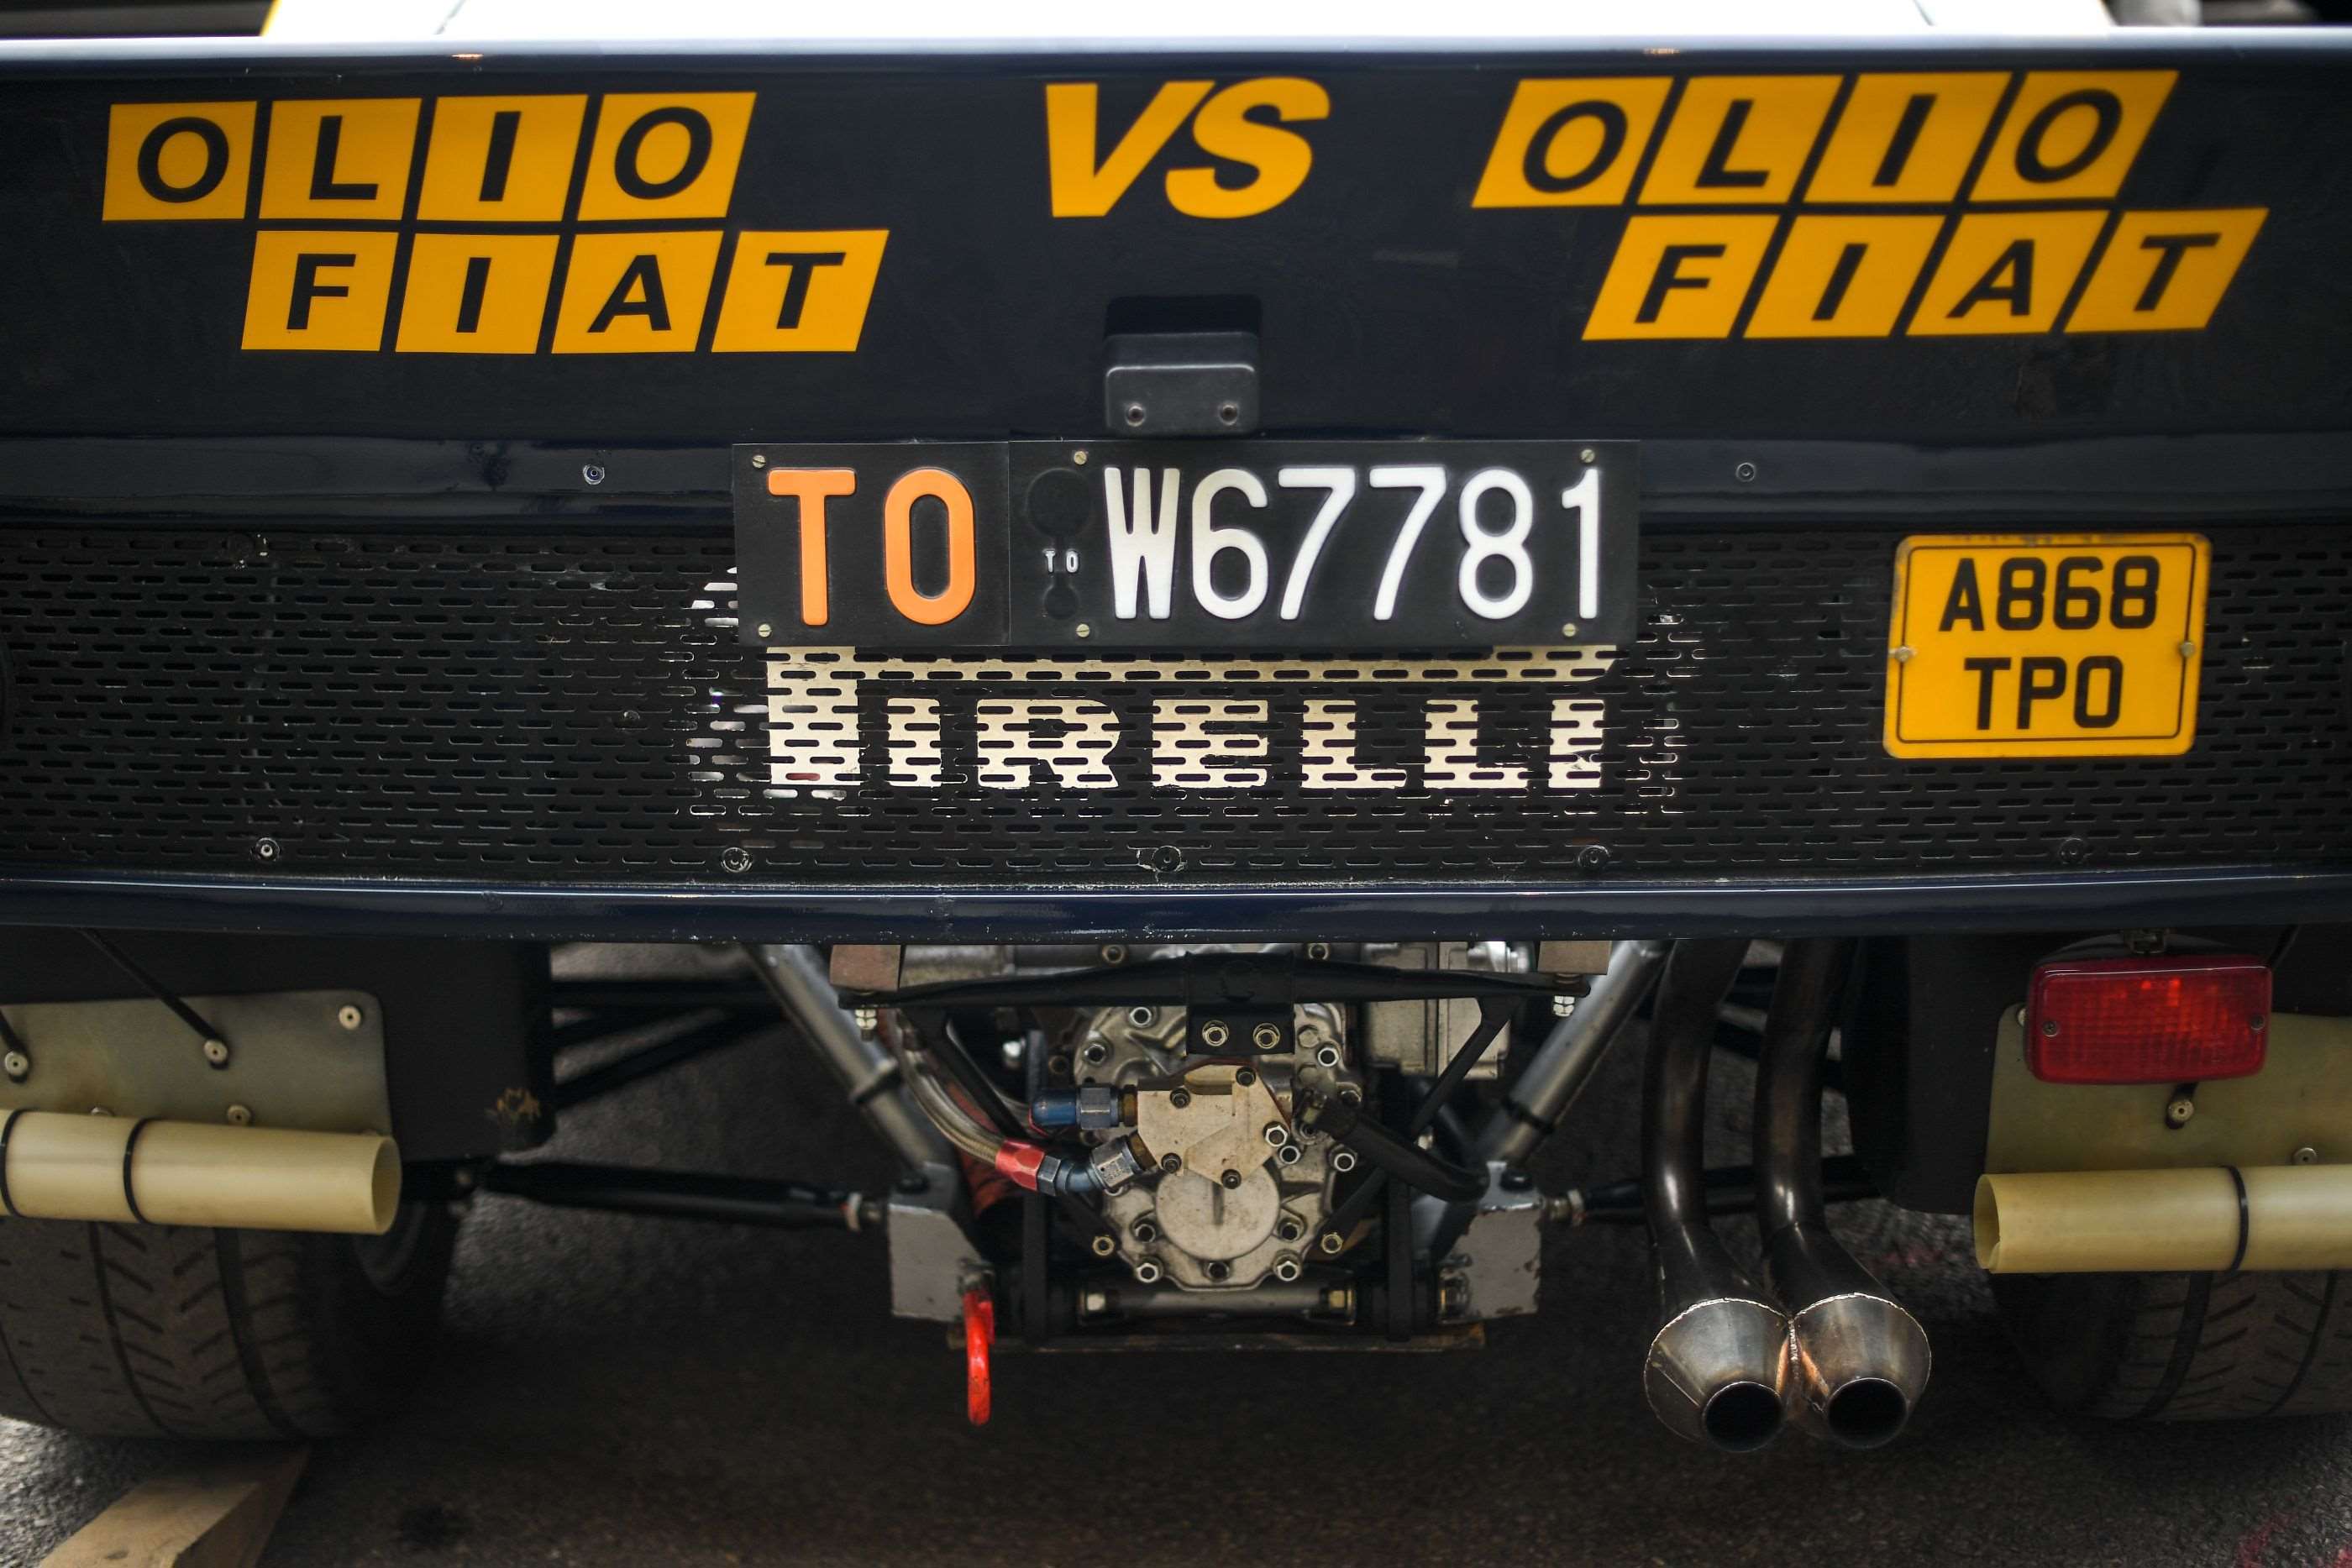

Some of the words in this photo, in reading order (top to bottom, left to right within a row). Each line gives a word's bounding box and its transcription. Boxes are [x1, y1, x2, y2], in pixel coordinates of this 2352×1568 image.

[137, 108, 711, 203] OLIO
[1046, 77, 1330, 218] VS
[1524, 88, 2123, 192] OLIO
[287, 253, 845, 333] FIAT
[1636, 233, 2219, 323] FIAT
[768, 468, 974, 625] TO
[1105, 465, 1600, 620] W67781
[1939, 555, 2160, 632] A868
[1964, 655, 2124, 730] TPO
